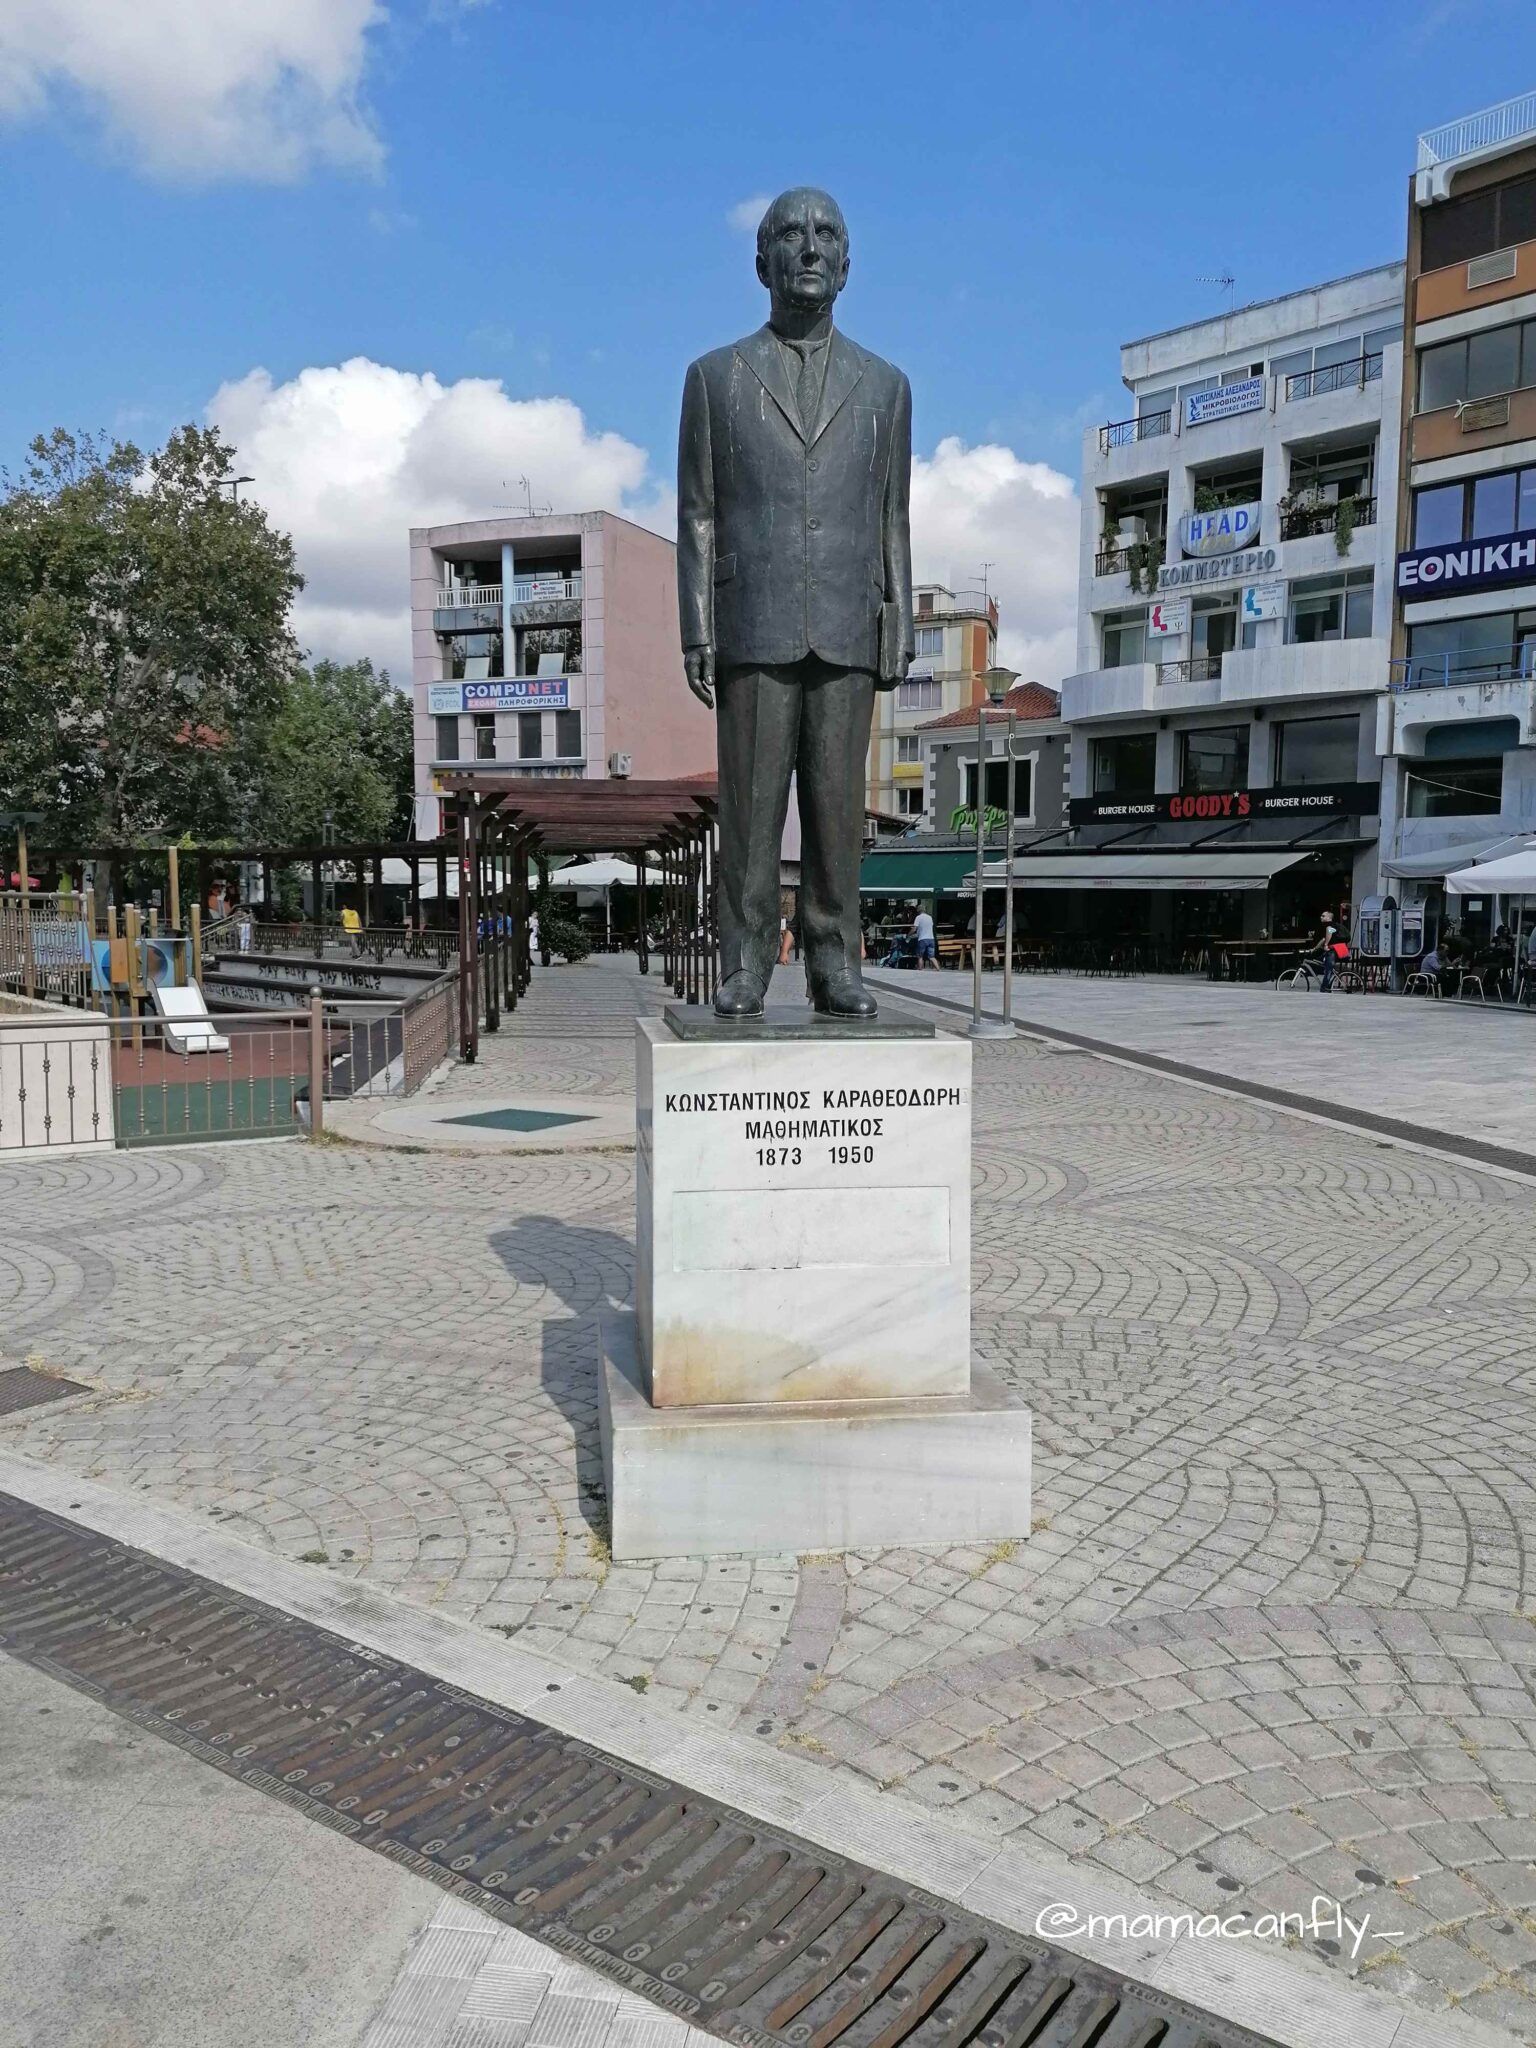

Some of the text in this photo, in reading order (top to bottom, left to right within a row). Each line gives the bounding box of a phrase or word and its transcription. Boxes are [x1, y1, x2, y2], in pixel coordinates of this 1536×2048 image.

[1203, 391, 1260, 410] ΜΙΚΡΟΒΙΟΛΟΓΟΣ
[1241, 399, 1260, 409] ΙΑΤΡΟΣ
[1190, 510, 1248, 541] HEAD
[1160, 549, 1276, 587] ΚΟΜΜΩΤΗΡΙΟ
[465, 682, 563, 698] COMPUNET
[498, 696, 564, 707] ΠΛΗΡΟΦΟΡΙΚΗΣ
[1098, 804, 1156, 815] BURGER HOUSE
[1169, 793, 1250, 818] GOODY'S
[1265, 796, 1334, 808] BURGER HOUSE
[666, 1091, 811, 1112] ΚΩΝΣΤΑΝΤΙΝΟΣ
[745, 1118, 884, 1140] ΜΑΘΗΜΑΤΙΚΟΣ
[756, 1145, 874, 1166] 1873 1950
